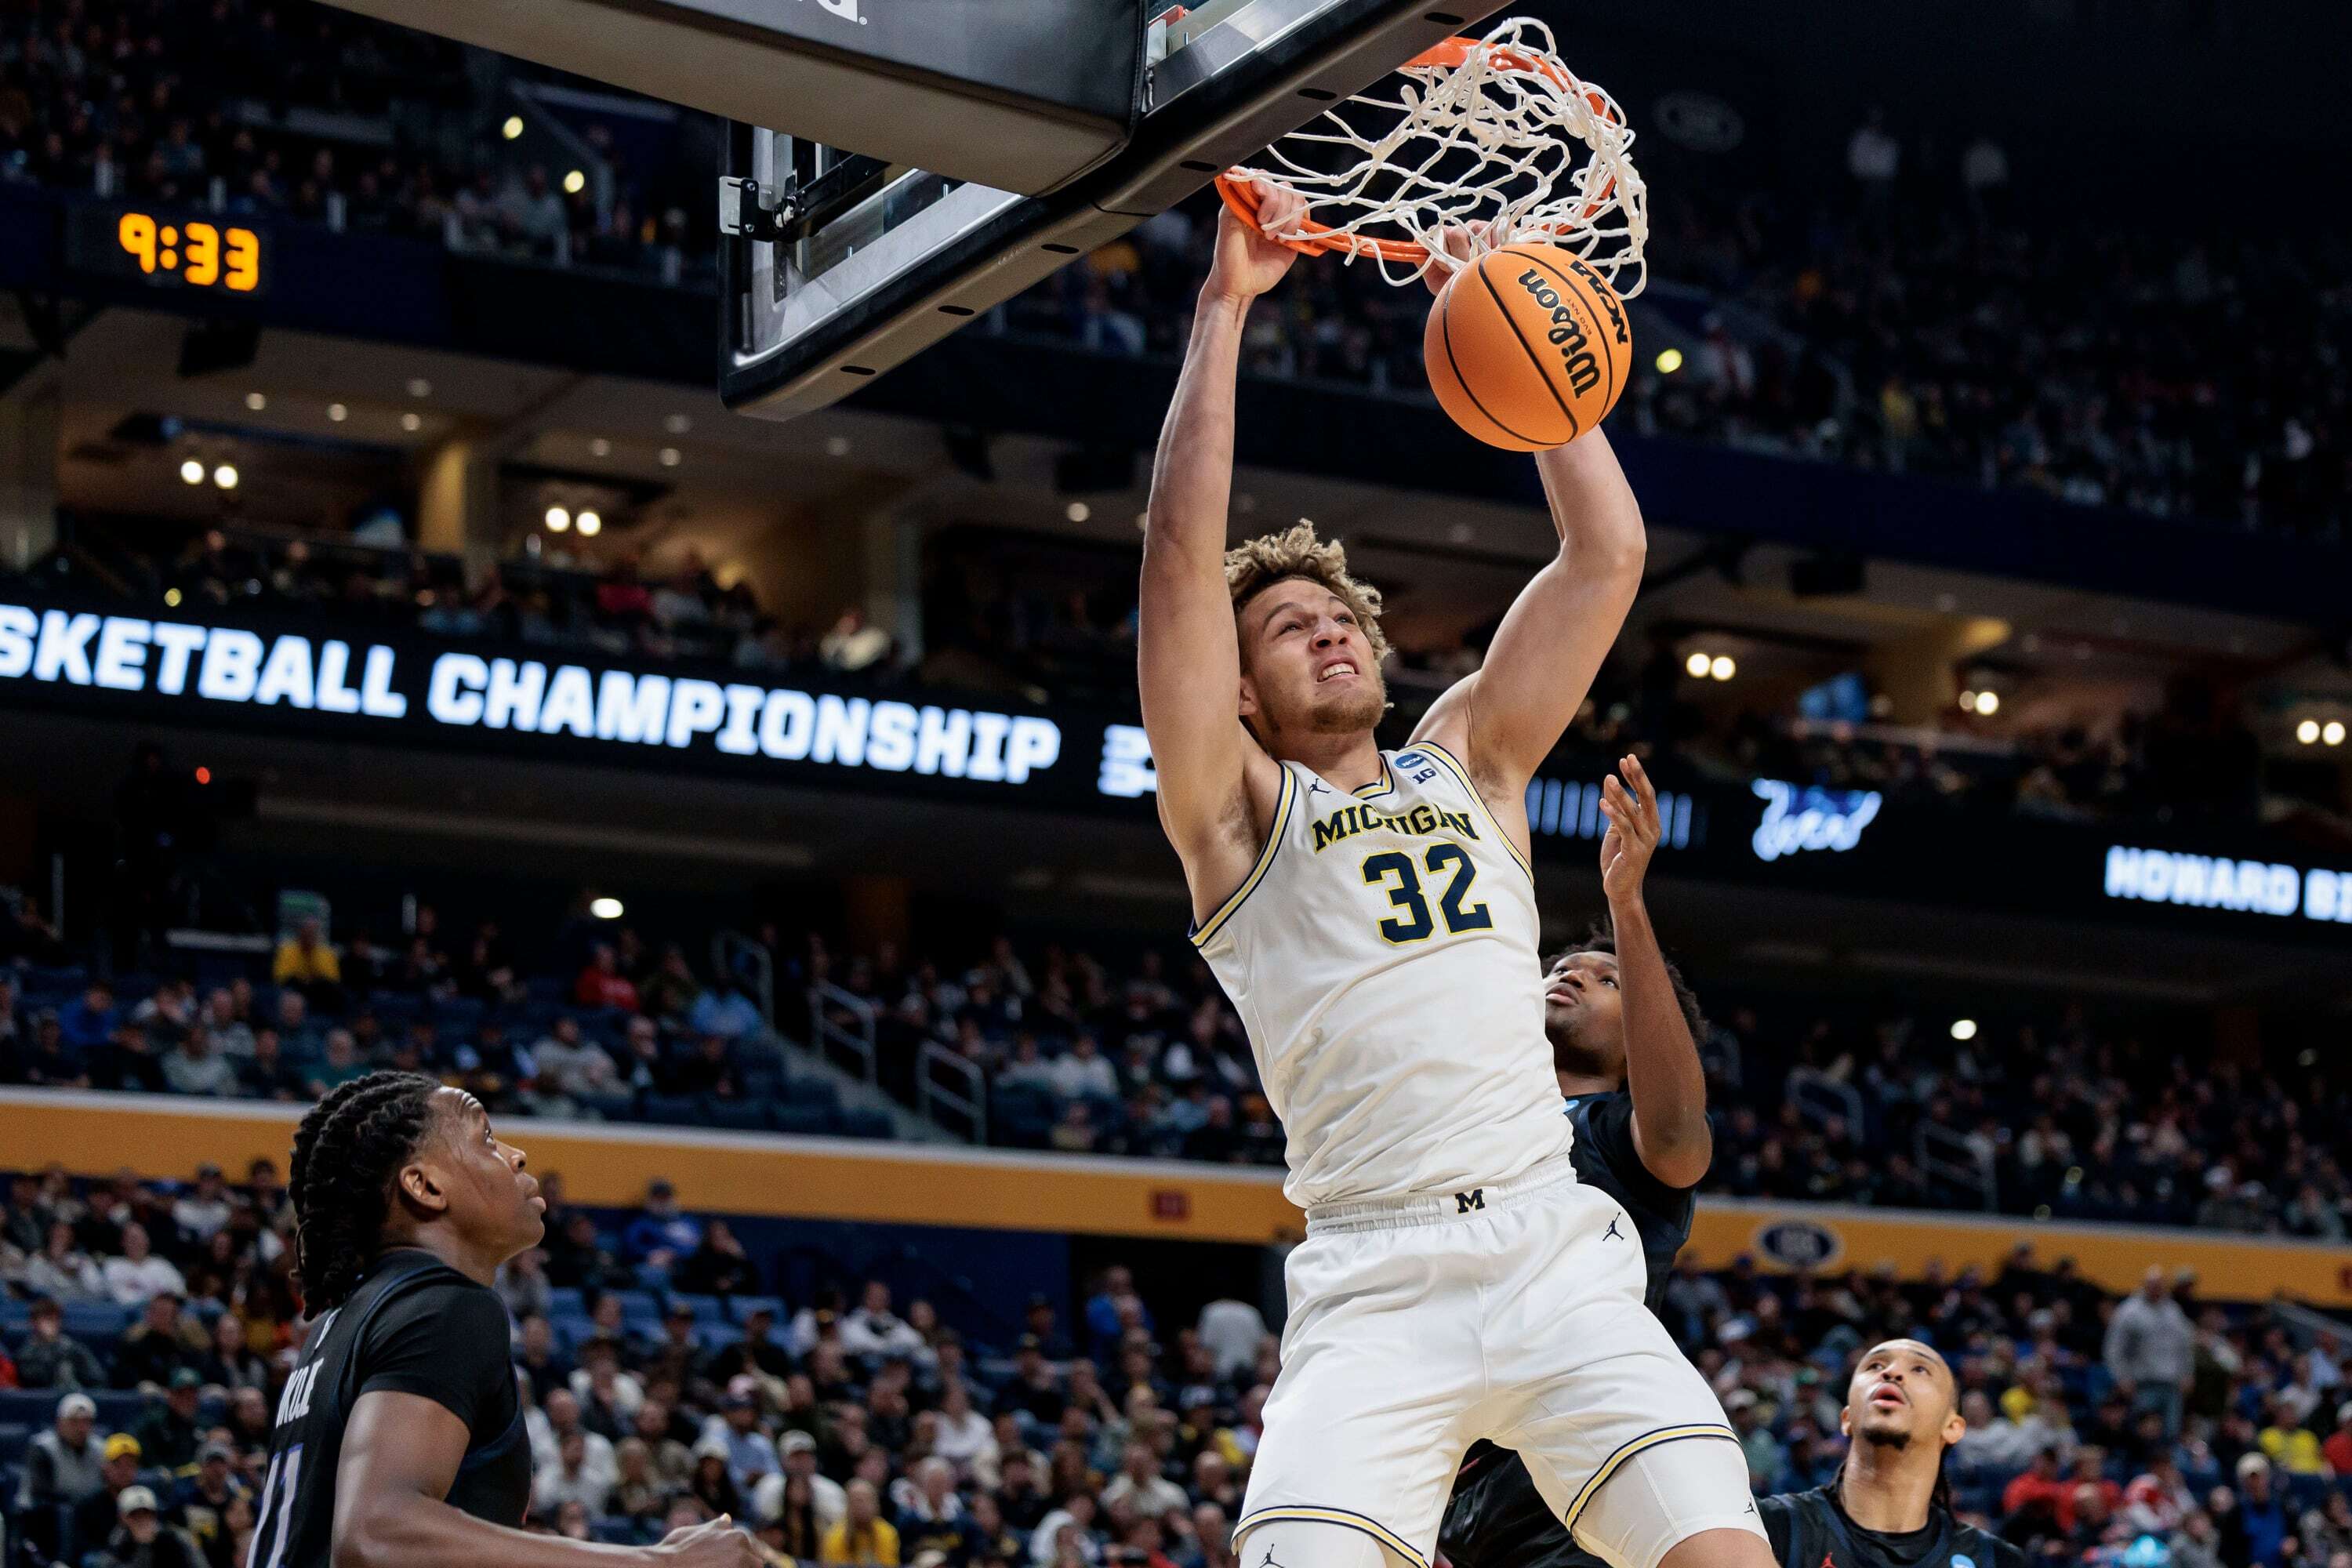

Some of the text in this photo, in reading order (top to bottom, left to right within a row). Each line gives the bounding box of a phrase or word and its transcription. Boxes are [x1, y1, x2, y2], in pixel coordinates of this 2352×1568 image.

[120, 213, 258, 290] 9:33
[1518, 268, 1601, 399] Wilson
[1569, 260, 1628, 344] NCAA
[0, 604, 406, 717] SKETBALL
[428, 653, 1061, 783] CHAMPIONSHIP
[1359, 841, 1494, 946] 32
[2105, 846, 2299, 915] HOWARD
[1454, 1187, 1486, 1214] M
